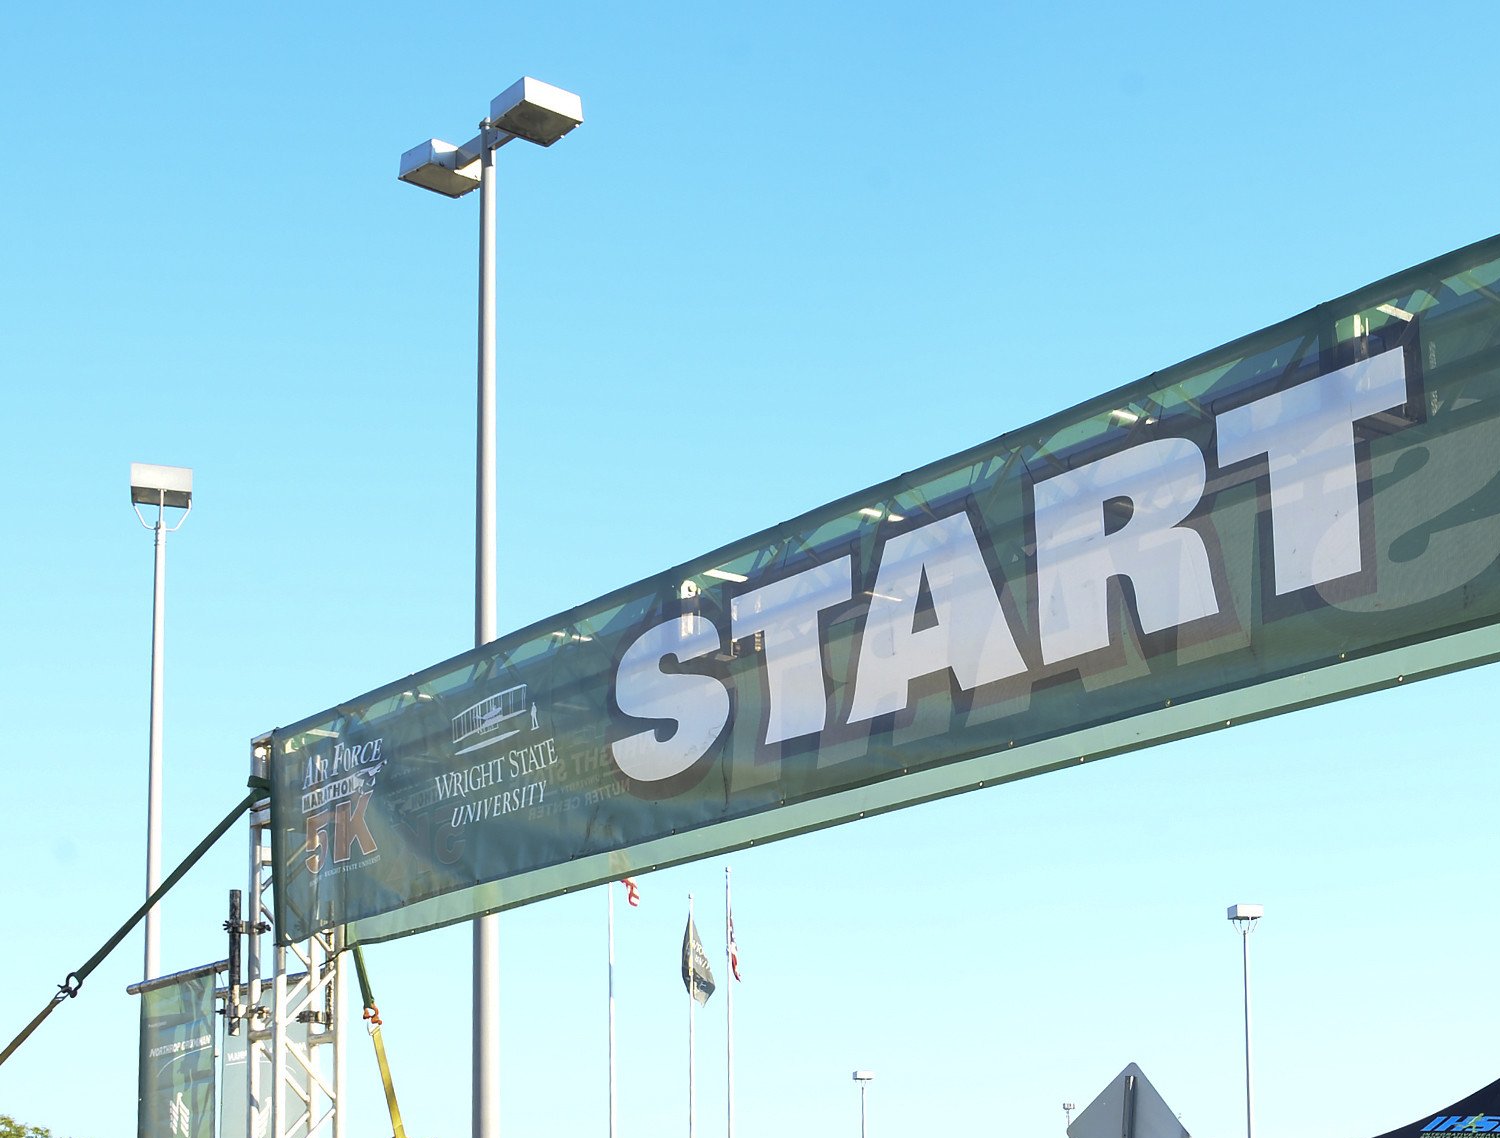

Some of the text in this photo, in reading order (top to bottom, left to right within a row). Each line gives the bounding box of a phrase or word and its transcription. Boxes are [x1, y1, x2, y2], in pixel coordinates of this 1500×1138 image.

[611, 346, 1407, 782] START
[302, 738, 383, 791] AIR FORCE
[305, 776, 357, 809] MARATHON
[434, 756, 505, 801] WRIGHT
[508, 738, 559, 779] STATE
[305, 790, 378, 874] 5K
[450, 780, 547, 828] UNIVERSITY
